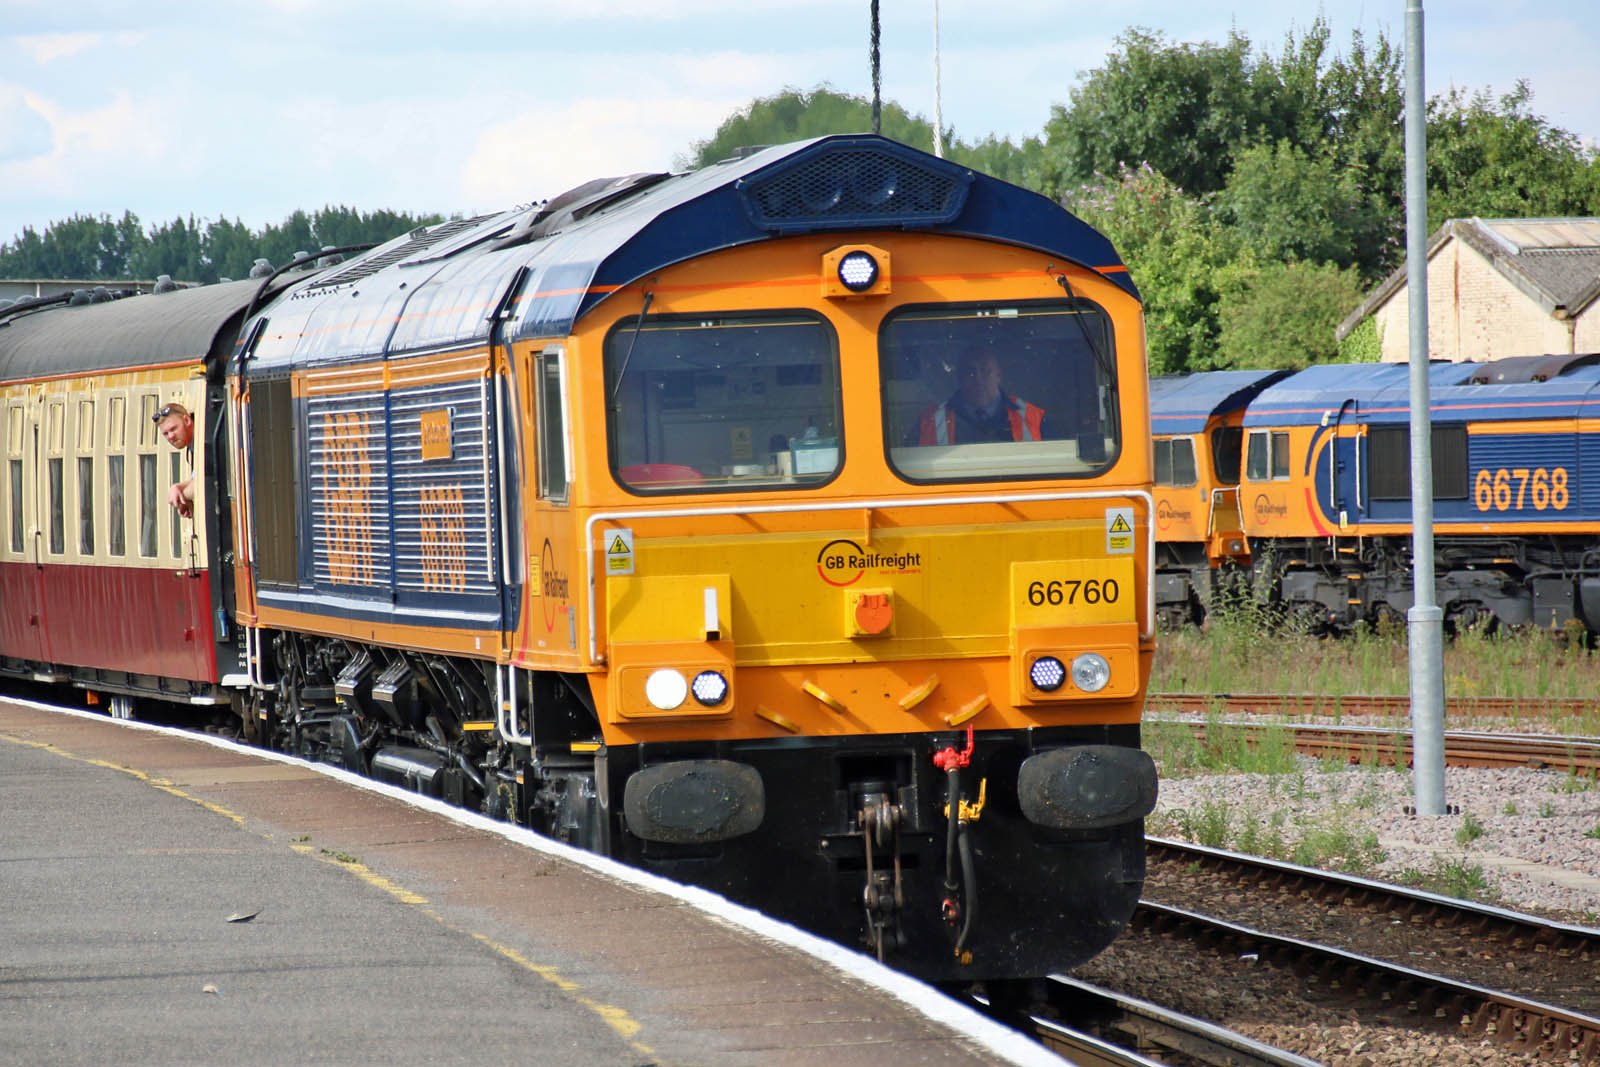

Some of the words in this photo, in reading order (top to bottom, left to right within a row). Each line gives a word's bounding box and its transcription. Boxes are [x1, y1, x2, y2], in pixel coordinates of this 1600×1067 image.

[1474, 467, 1569, 512] 66768
[419, 482, 467, 593] 66760
[825, 556, 845, 570] GB
[848, 552, 921, 570] Railfreight
[1028, 578, 1119, 606] 66760
